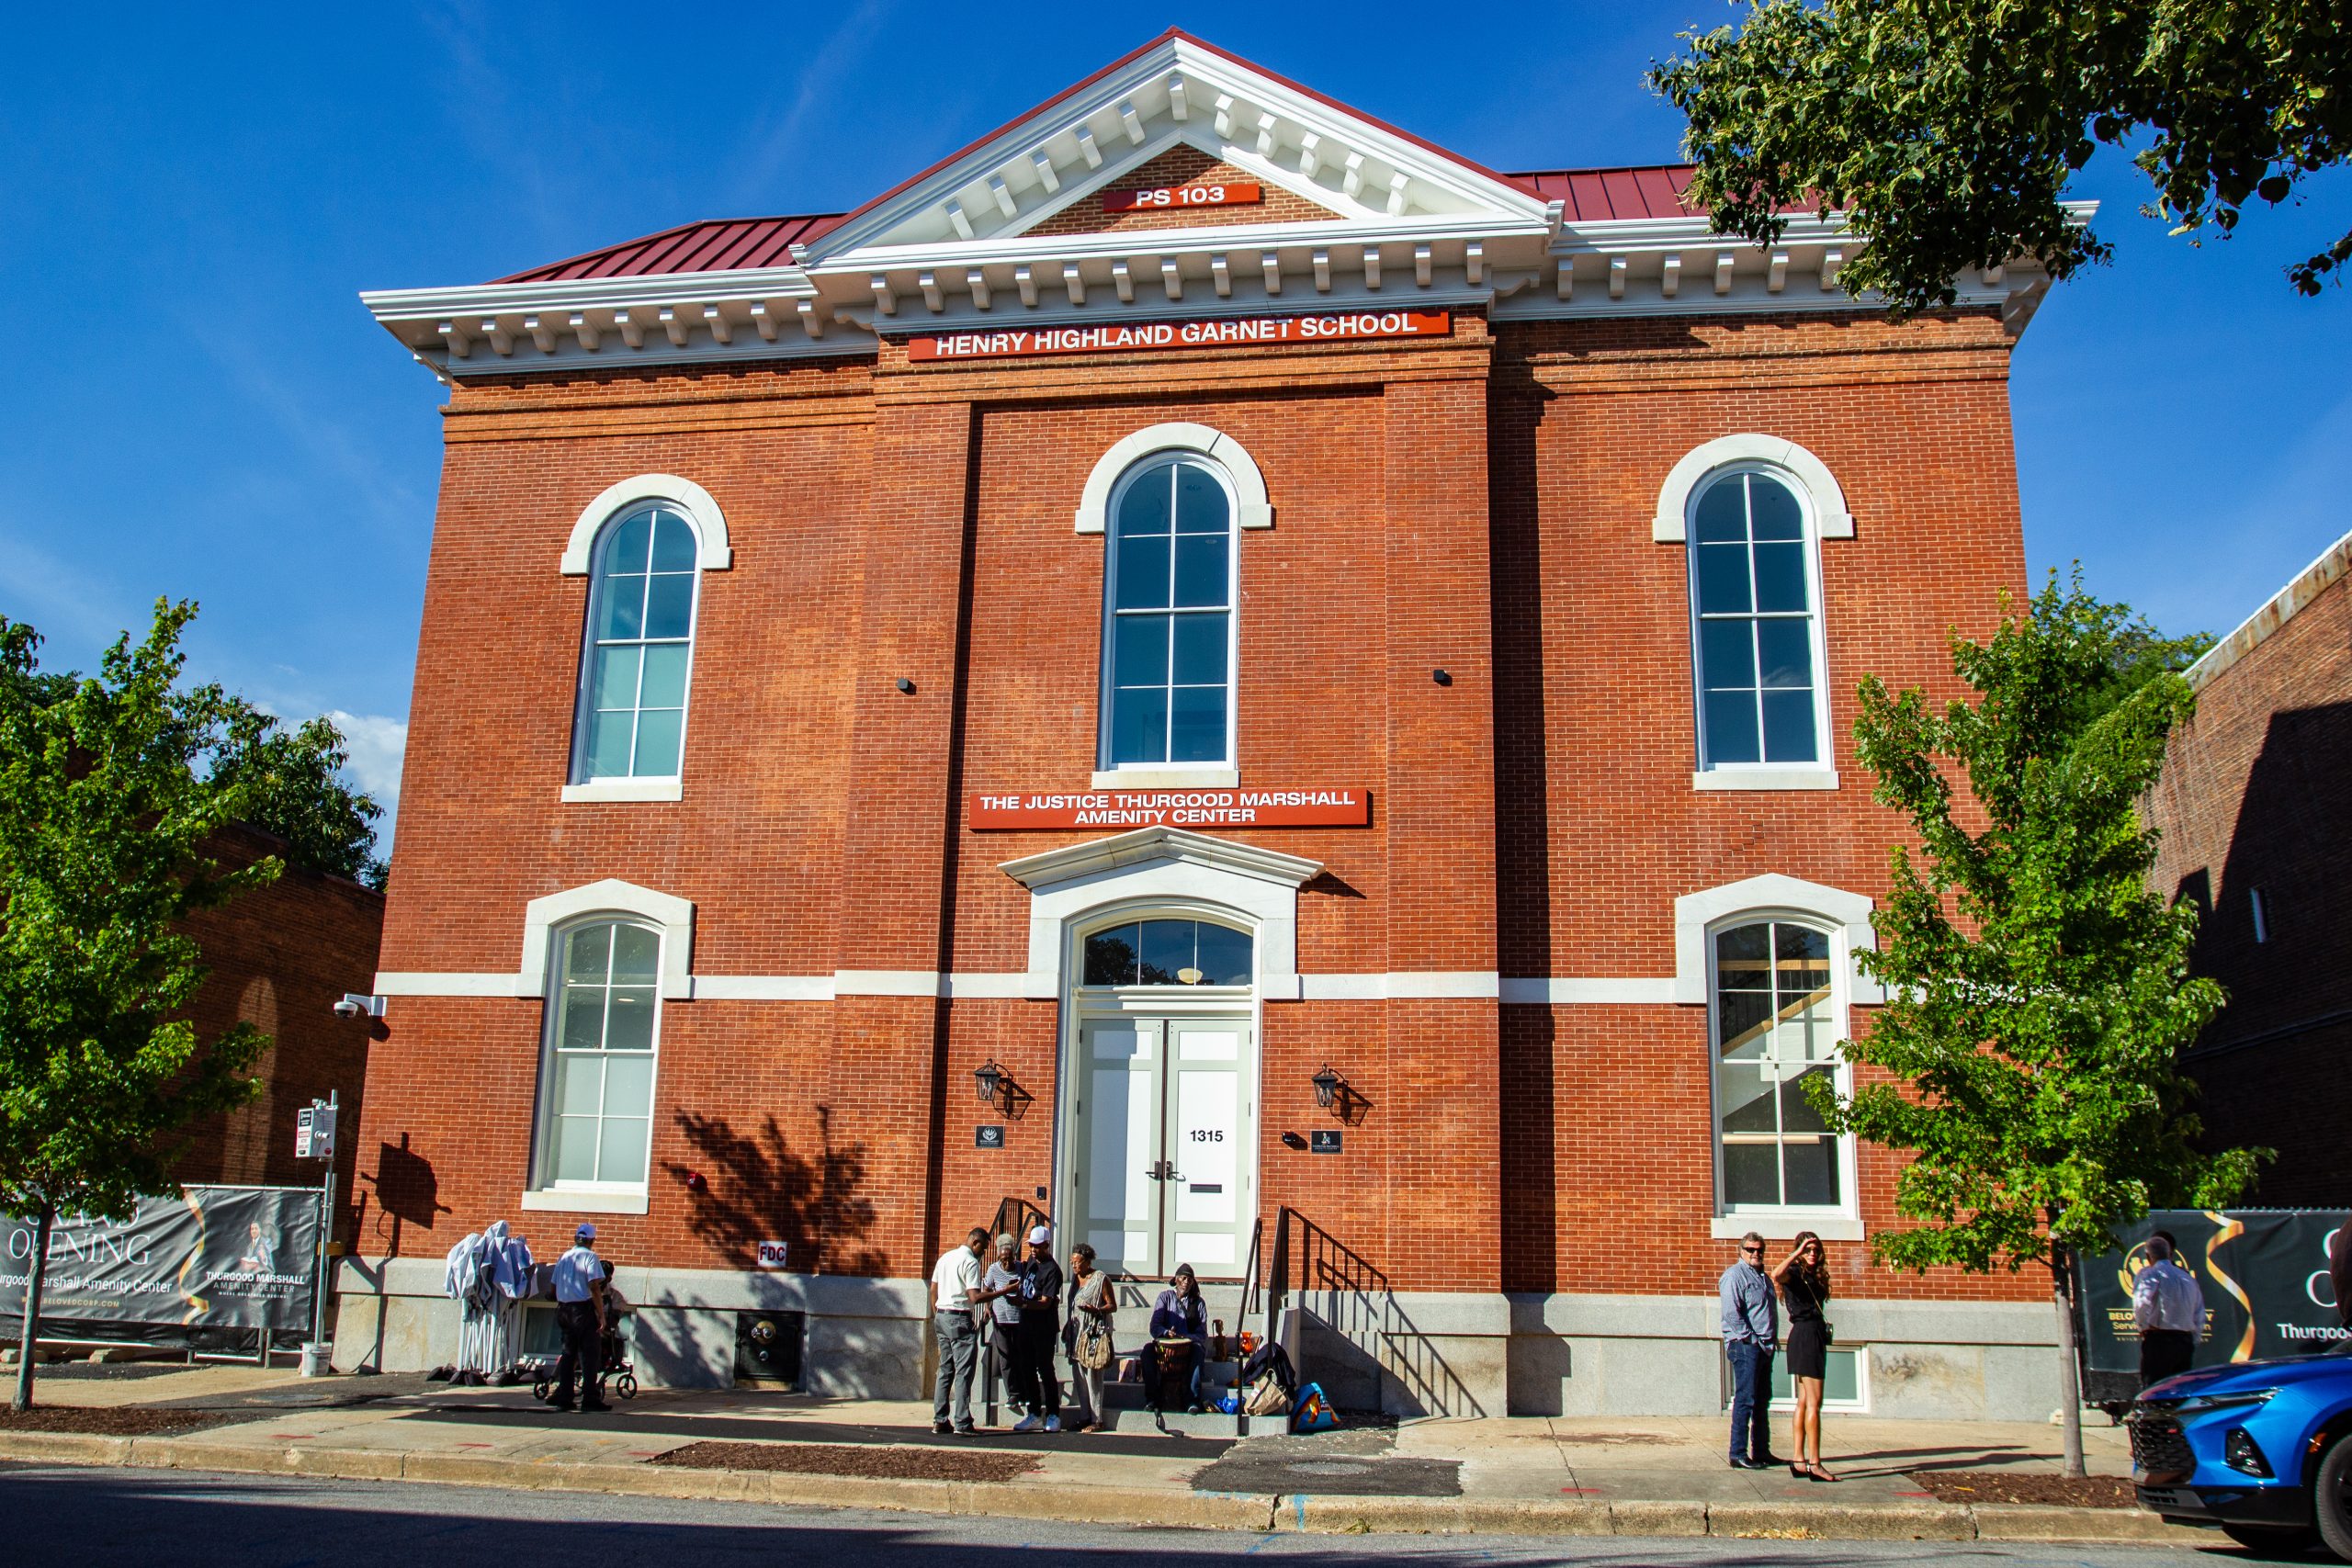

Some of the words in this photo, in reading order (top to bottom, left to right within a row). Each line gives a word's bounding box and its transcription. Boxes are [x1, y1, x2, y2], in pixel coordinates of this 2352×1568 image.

[1136, 189, 1170, 207] PS
[1179, 186, 1225, 204] 103
[936, 332, 1028, 355] HENRY
[1034, 325, 1173, 351] HIGHLAND
[1181, 318, 1294, 343] GARNET
[1300, 313, 1418, 337] SCHOOL
[980, 796, 1020, 810] THE
[1024, 795, 1110, 809] JUSTICE
[1114, 793, 1233, 808] THURGOOD
[1240, 792, 1356, 807] MARSHALL
[1074, 809, 1167, 824] AMENITY
[1172, 808, 1256, 823] CENTER
[1190, 1130, 1224, 1142] 1315
[759, 1246, 786, 1262] FDC
[0, 1273, 30, 1288] rgood
[41, 1275, 81, 1289] arshall
[82, 1277, 131, 1293] Amenity
[133, 1279, 173, 1293] Center
[206, 1271, 254, 1282] THURGOOD
[255, 1273, 305, 1285] MARSHALL
[212, 1281, 255, 1291] AMENITY
[259, 1283, 295, 1292] CENTER
[2109, 1312, 2134, 1321] BELO
